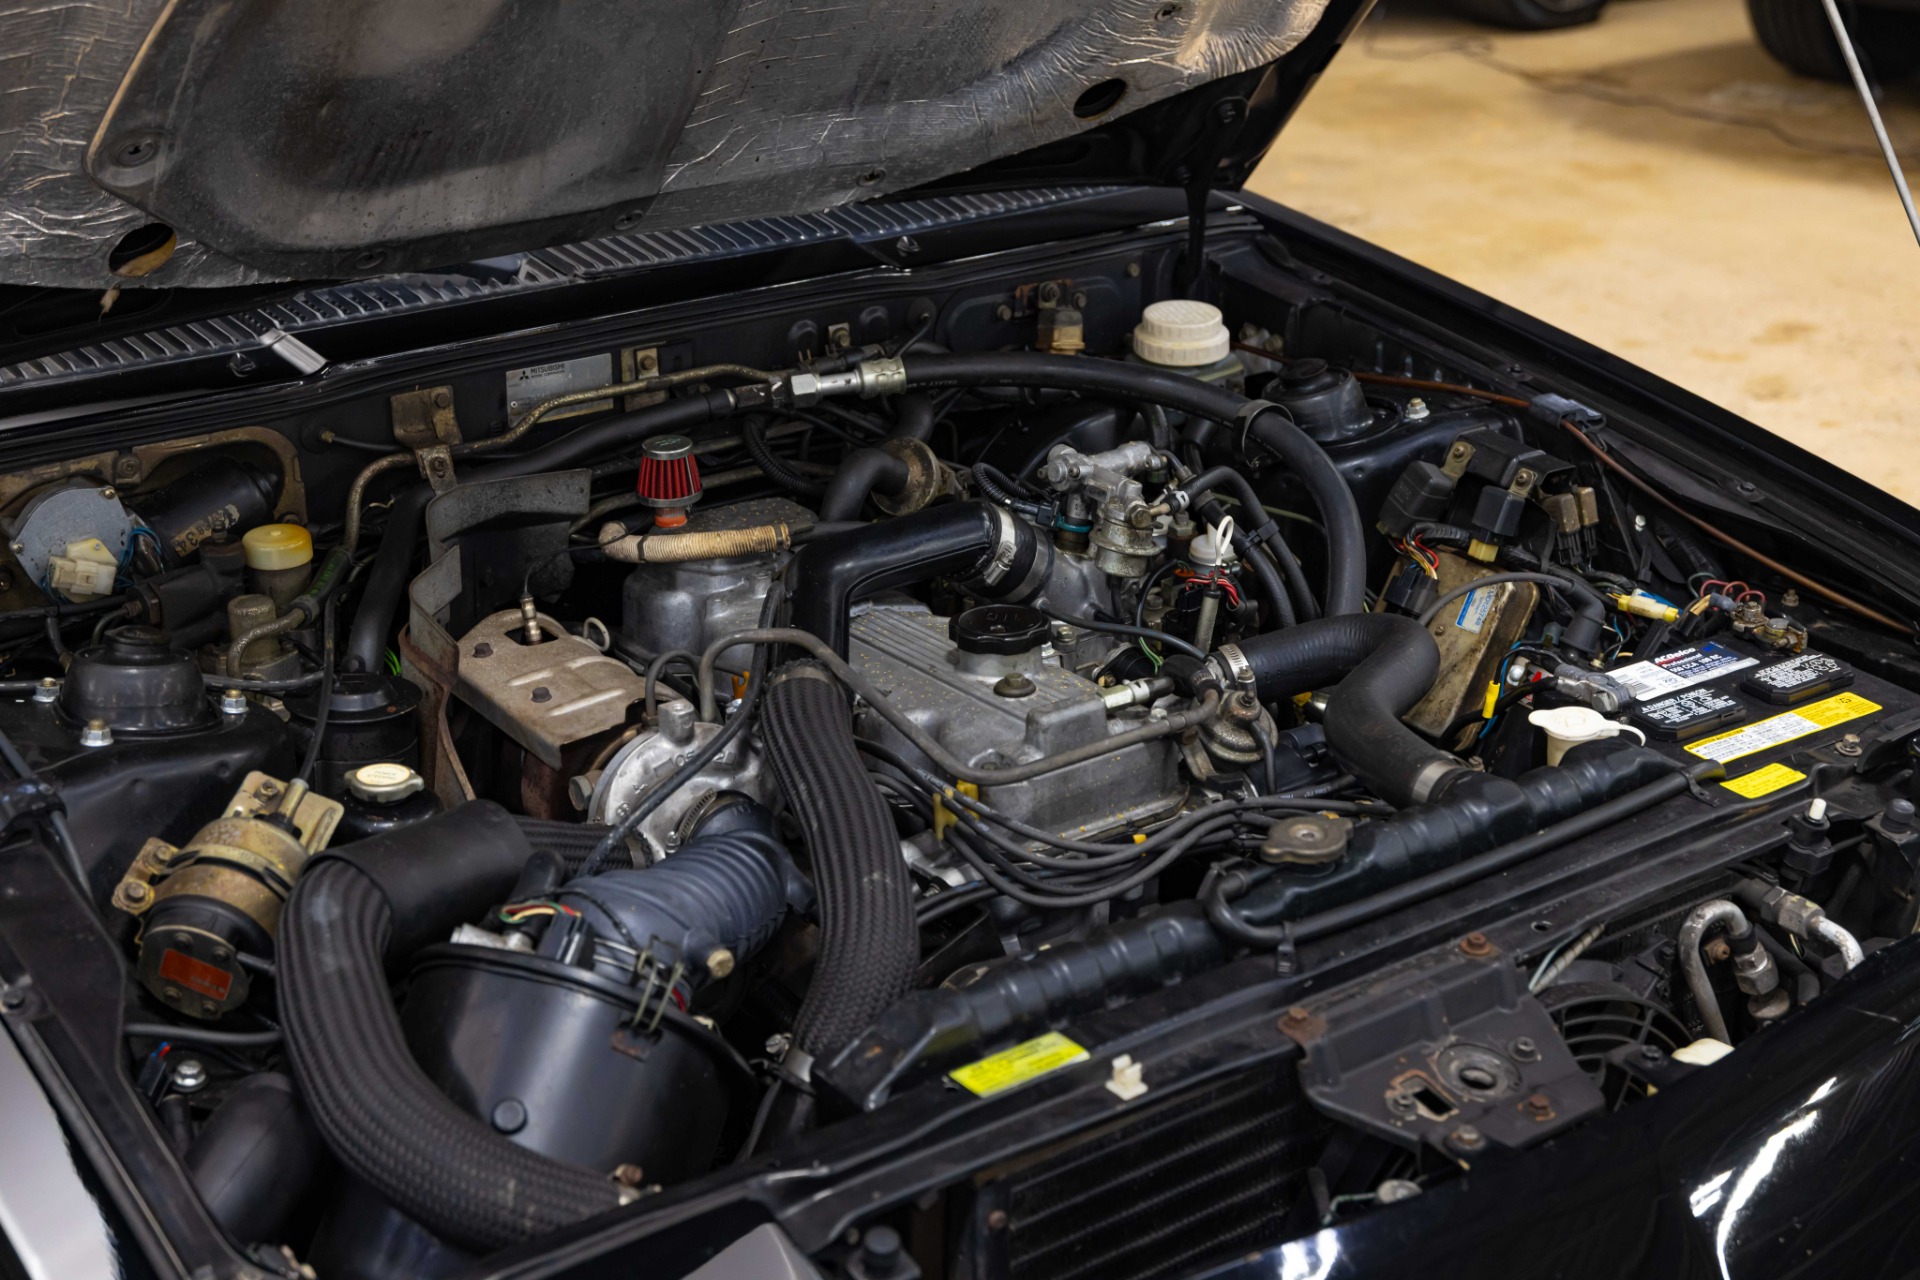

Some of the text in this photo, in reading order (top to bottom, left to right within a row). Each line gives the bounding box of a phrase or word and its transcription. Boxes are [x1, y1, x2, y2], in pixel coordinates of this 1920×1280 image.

[530, 363, 565, 374] MITSUBISHI
[1654, 647, 1696, 663] ACDelco
[1661, 653, 1704, 668] Professional
